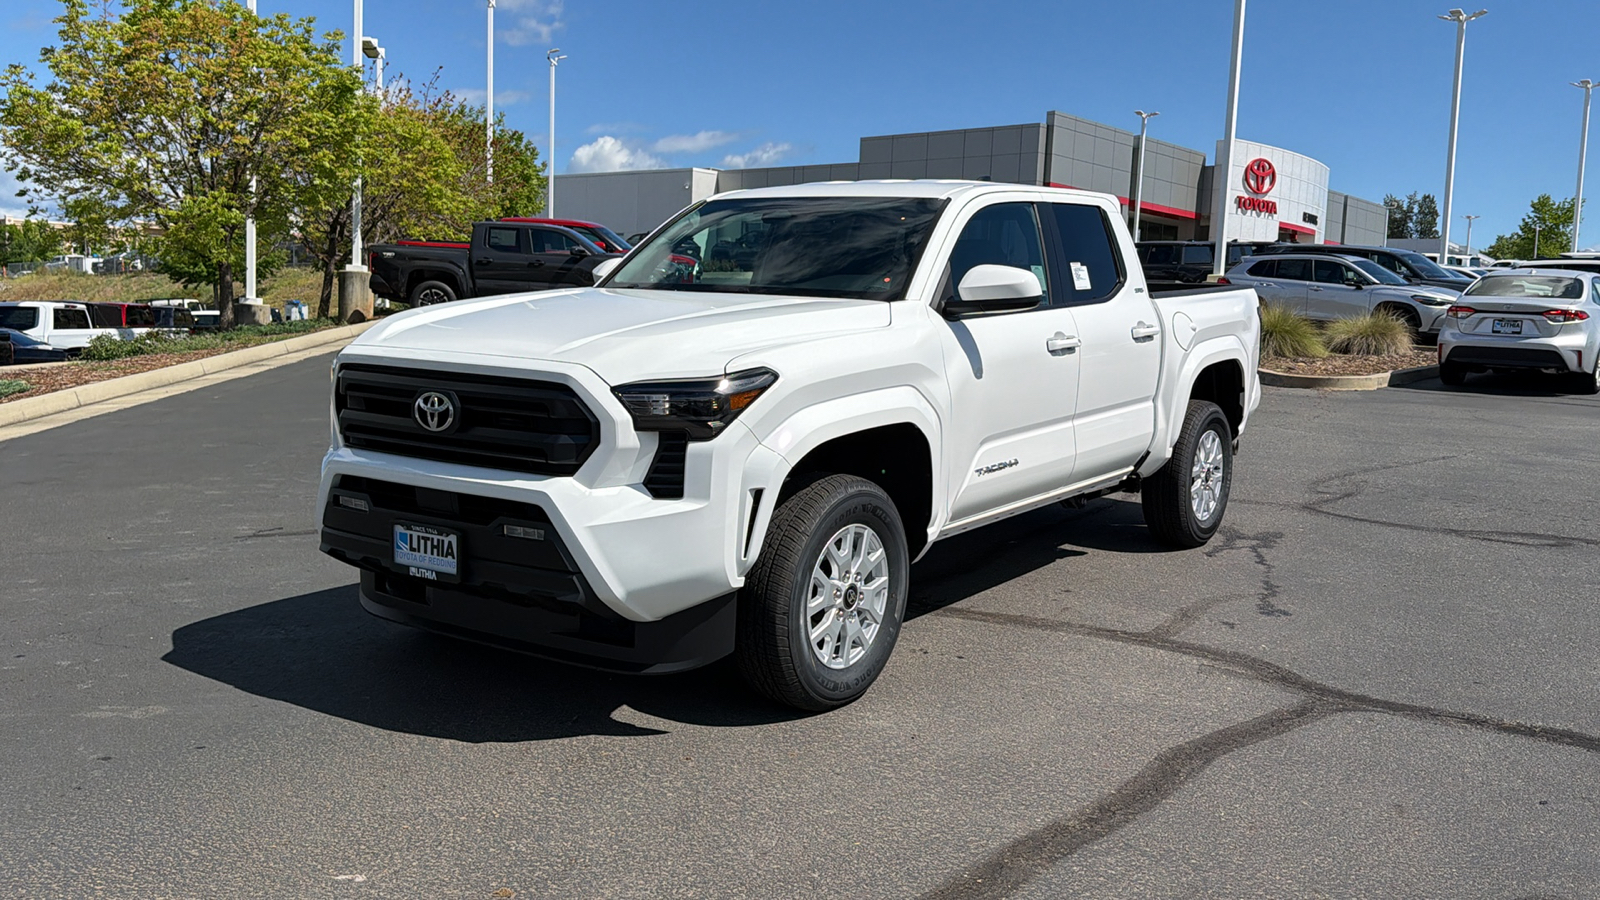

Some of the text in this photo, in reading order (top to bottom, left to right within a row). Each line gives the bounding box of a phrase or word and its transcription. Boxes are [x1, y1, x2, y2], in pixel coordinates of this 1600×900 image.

[1236, 196, 1277, 214] TOYOTA
[974, 458, 1019, 477] TACOMA
[409, 533, 455, 559] LITHIA
[396, 551, 418, 561] TOYOTA
[429, 557, 456, 569] REDDING
[415, 567, 437, 580] LITHIA
